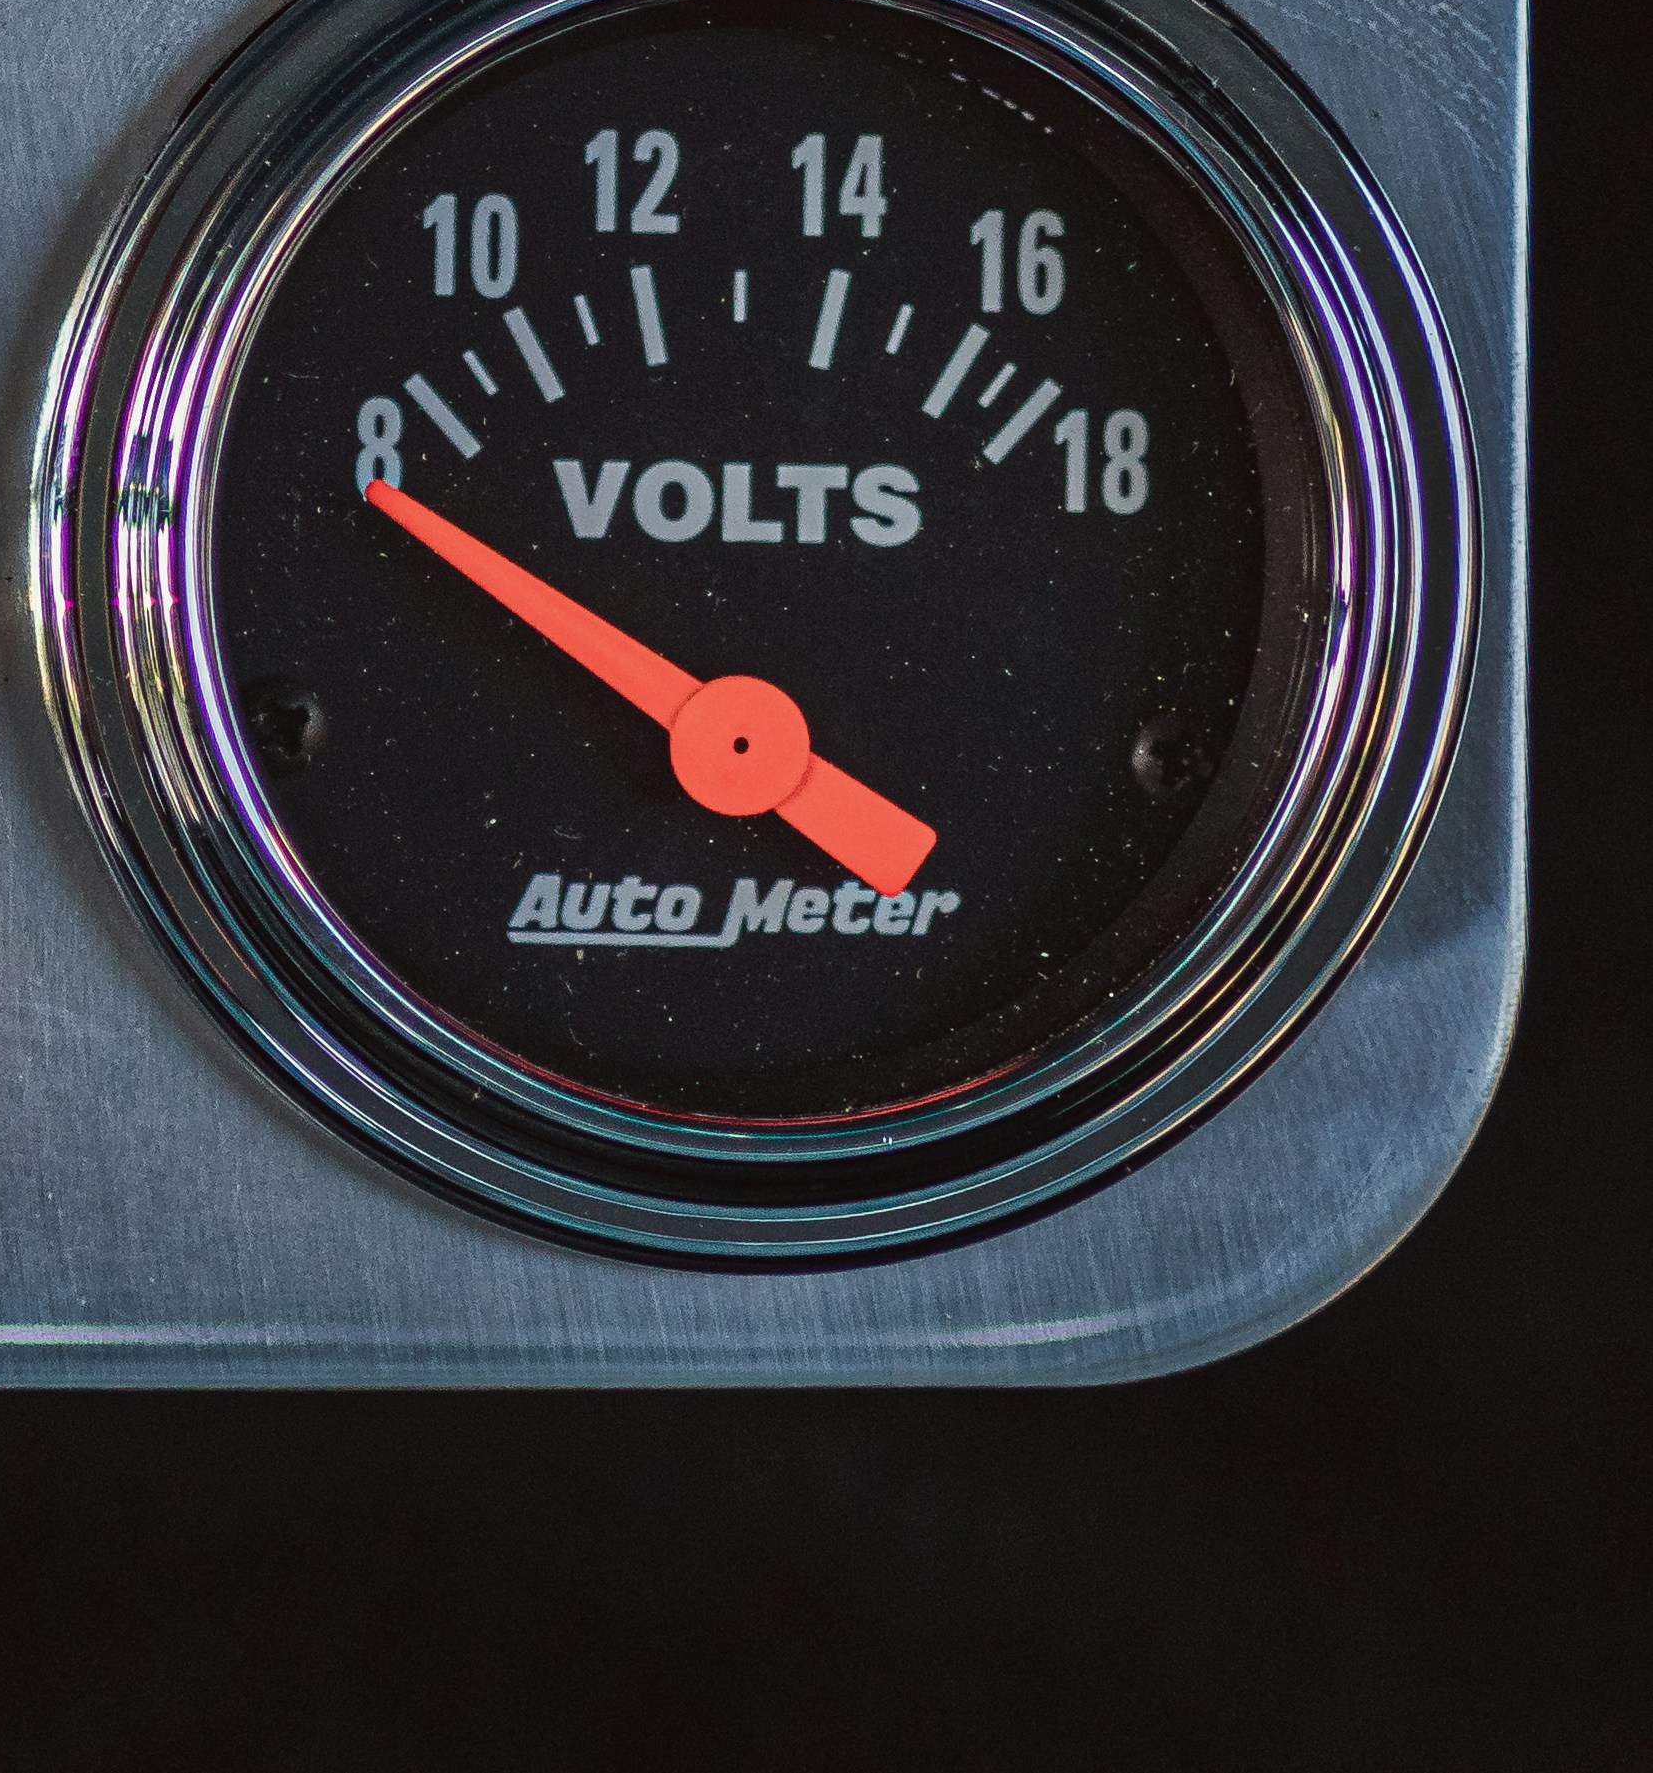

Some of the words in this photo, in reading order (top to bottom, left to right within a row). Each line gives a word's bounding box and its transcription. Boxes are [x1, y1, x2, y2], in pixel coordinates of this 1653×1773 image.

[583, 129, 680, 234] 12
[791, 133, 888, 239] 14
[422, 193, 519, 299] 10
[970, 208, 1066, 315] 16
[356, 395, 403, 500] 8
[1054, 408, 1151, 516] 18
[553, 458, 923, 549] VOLTS
[506, 875, 702, 946] Auto
[718, 875, 960, 947] Meter
